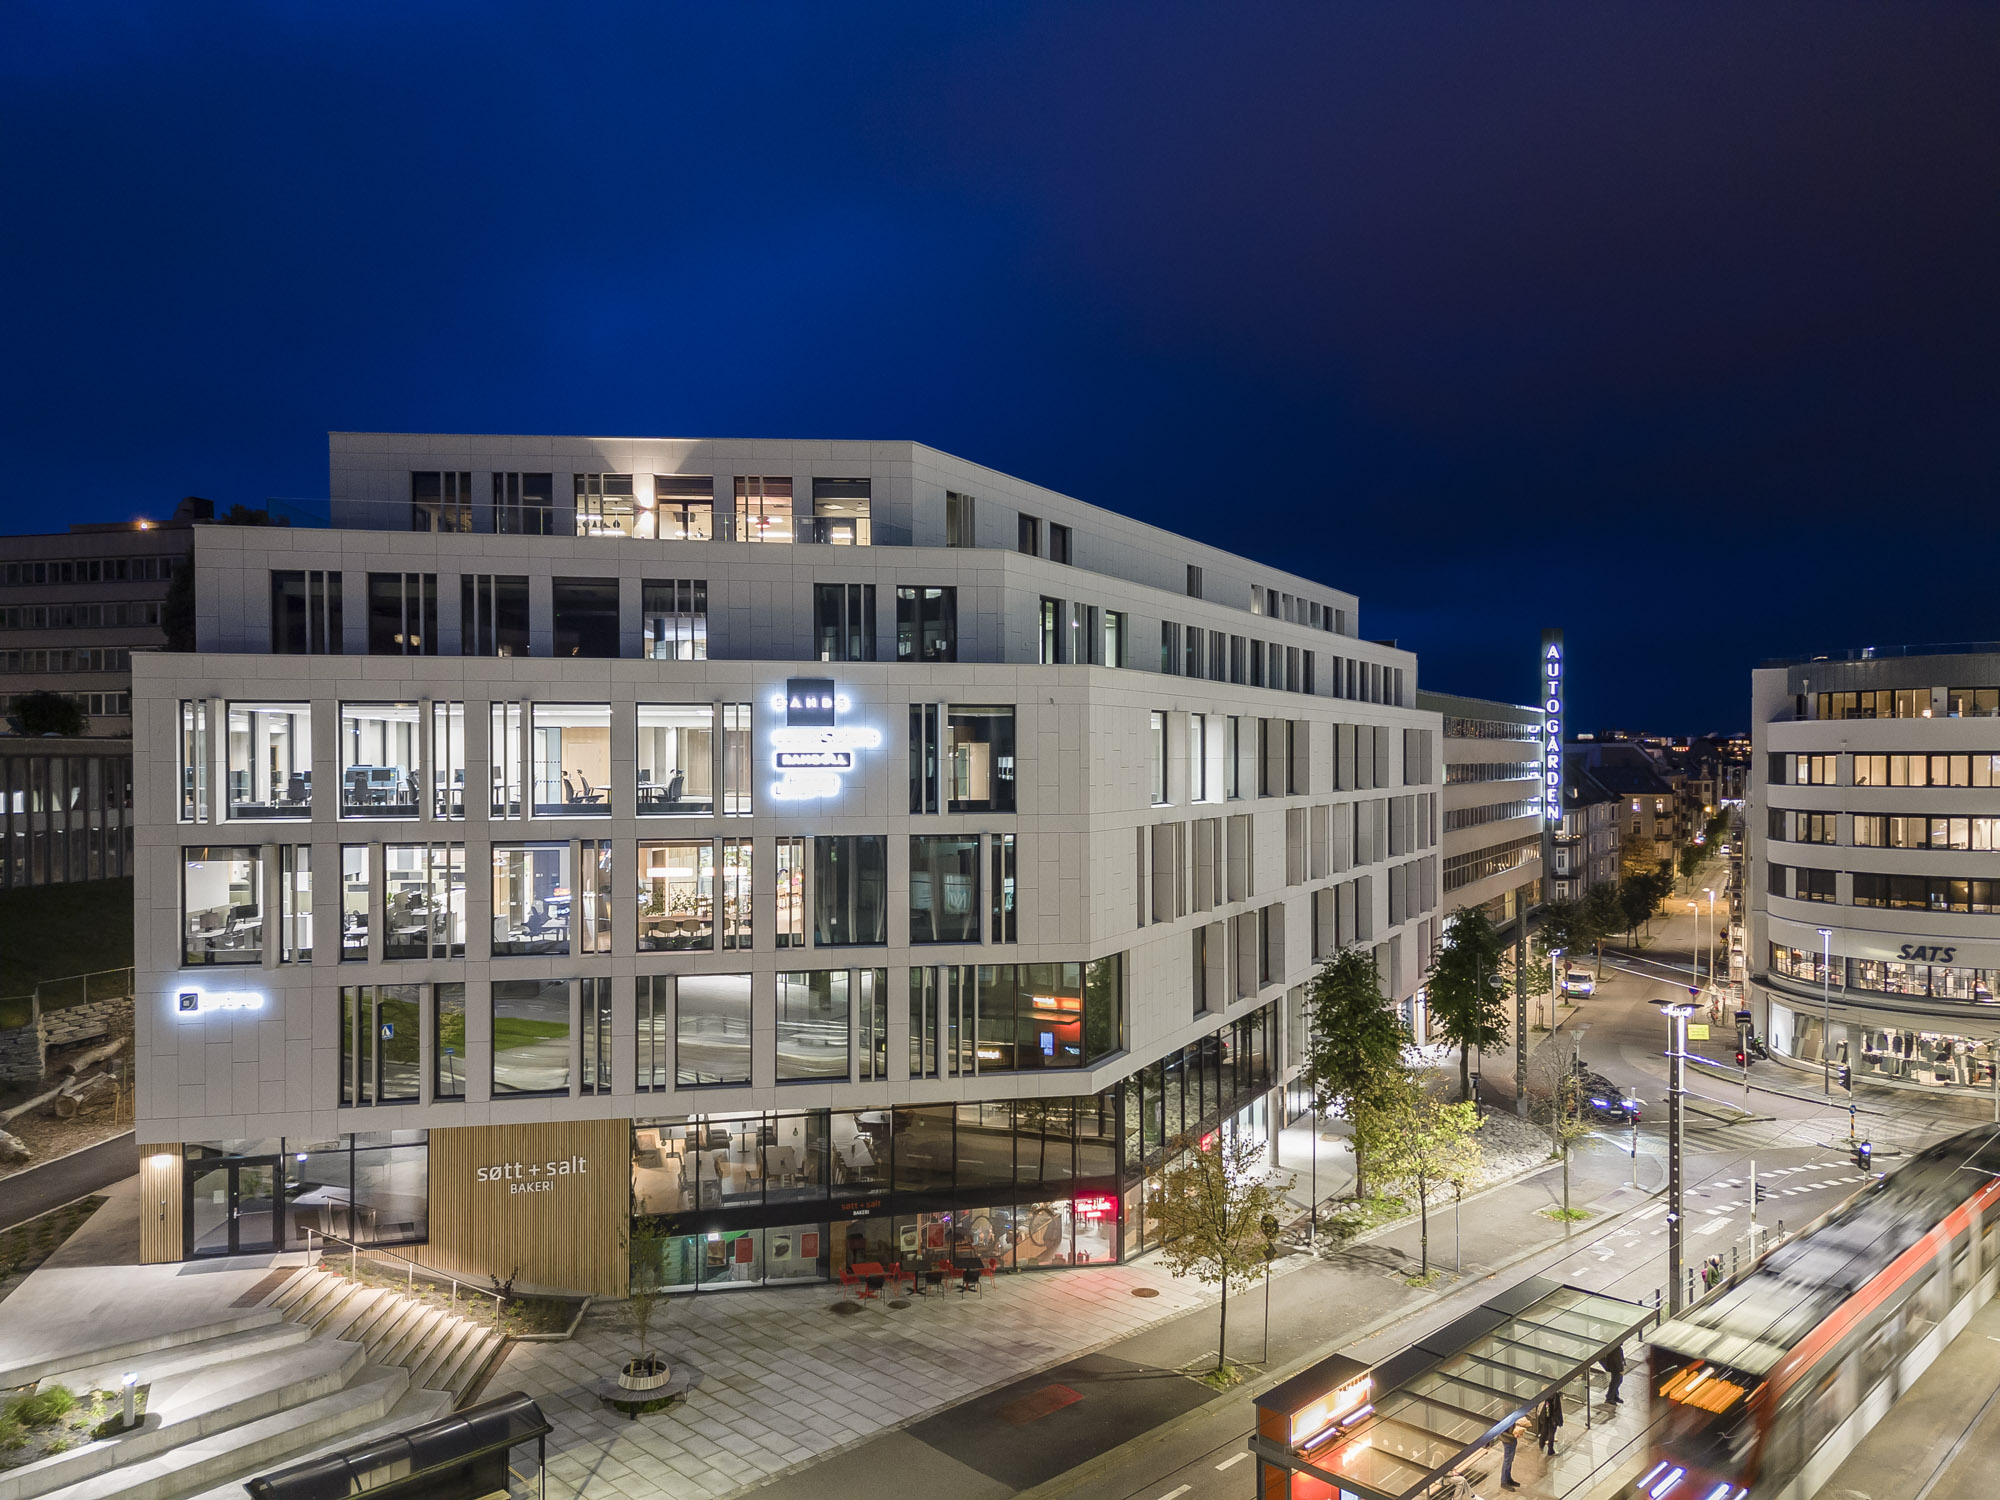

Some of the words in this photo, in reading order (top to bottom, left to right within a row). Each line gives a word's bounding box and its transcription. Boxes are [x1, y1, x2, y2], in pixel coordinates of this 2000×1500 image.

[1546, 645, 1560, 819] AUTOGÅRDEN
[1896, 944, 1957, 964] SATS
[477, 1162, 522, 1182] søtt
[546, 1155, 587, 1176] salt
[510, 1180, 554, 1195] BAKERI
